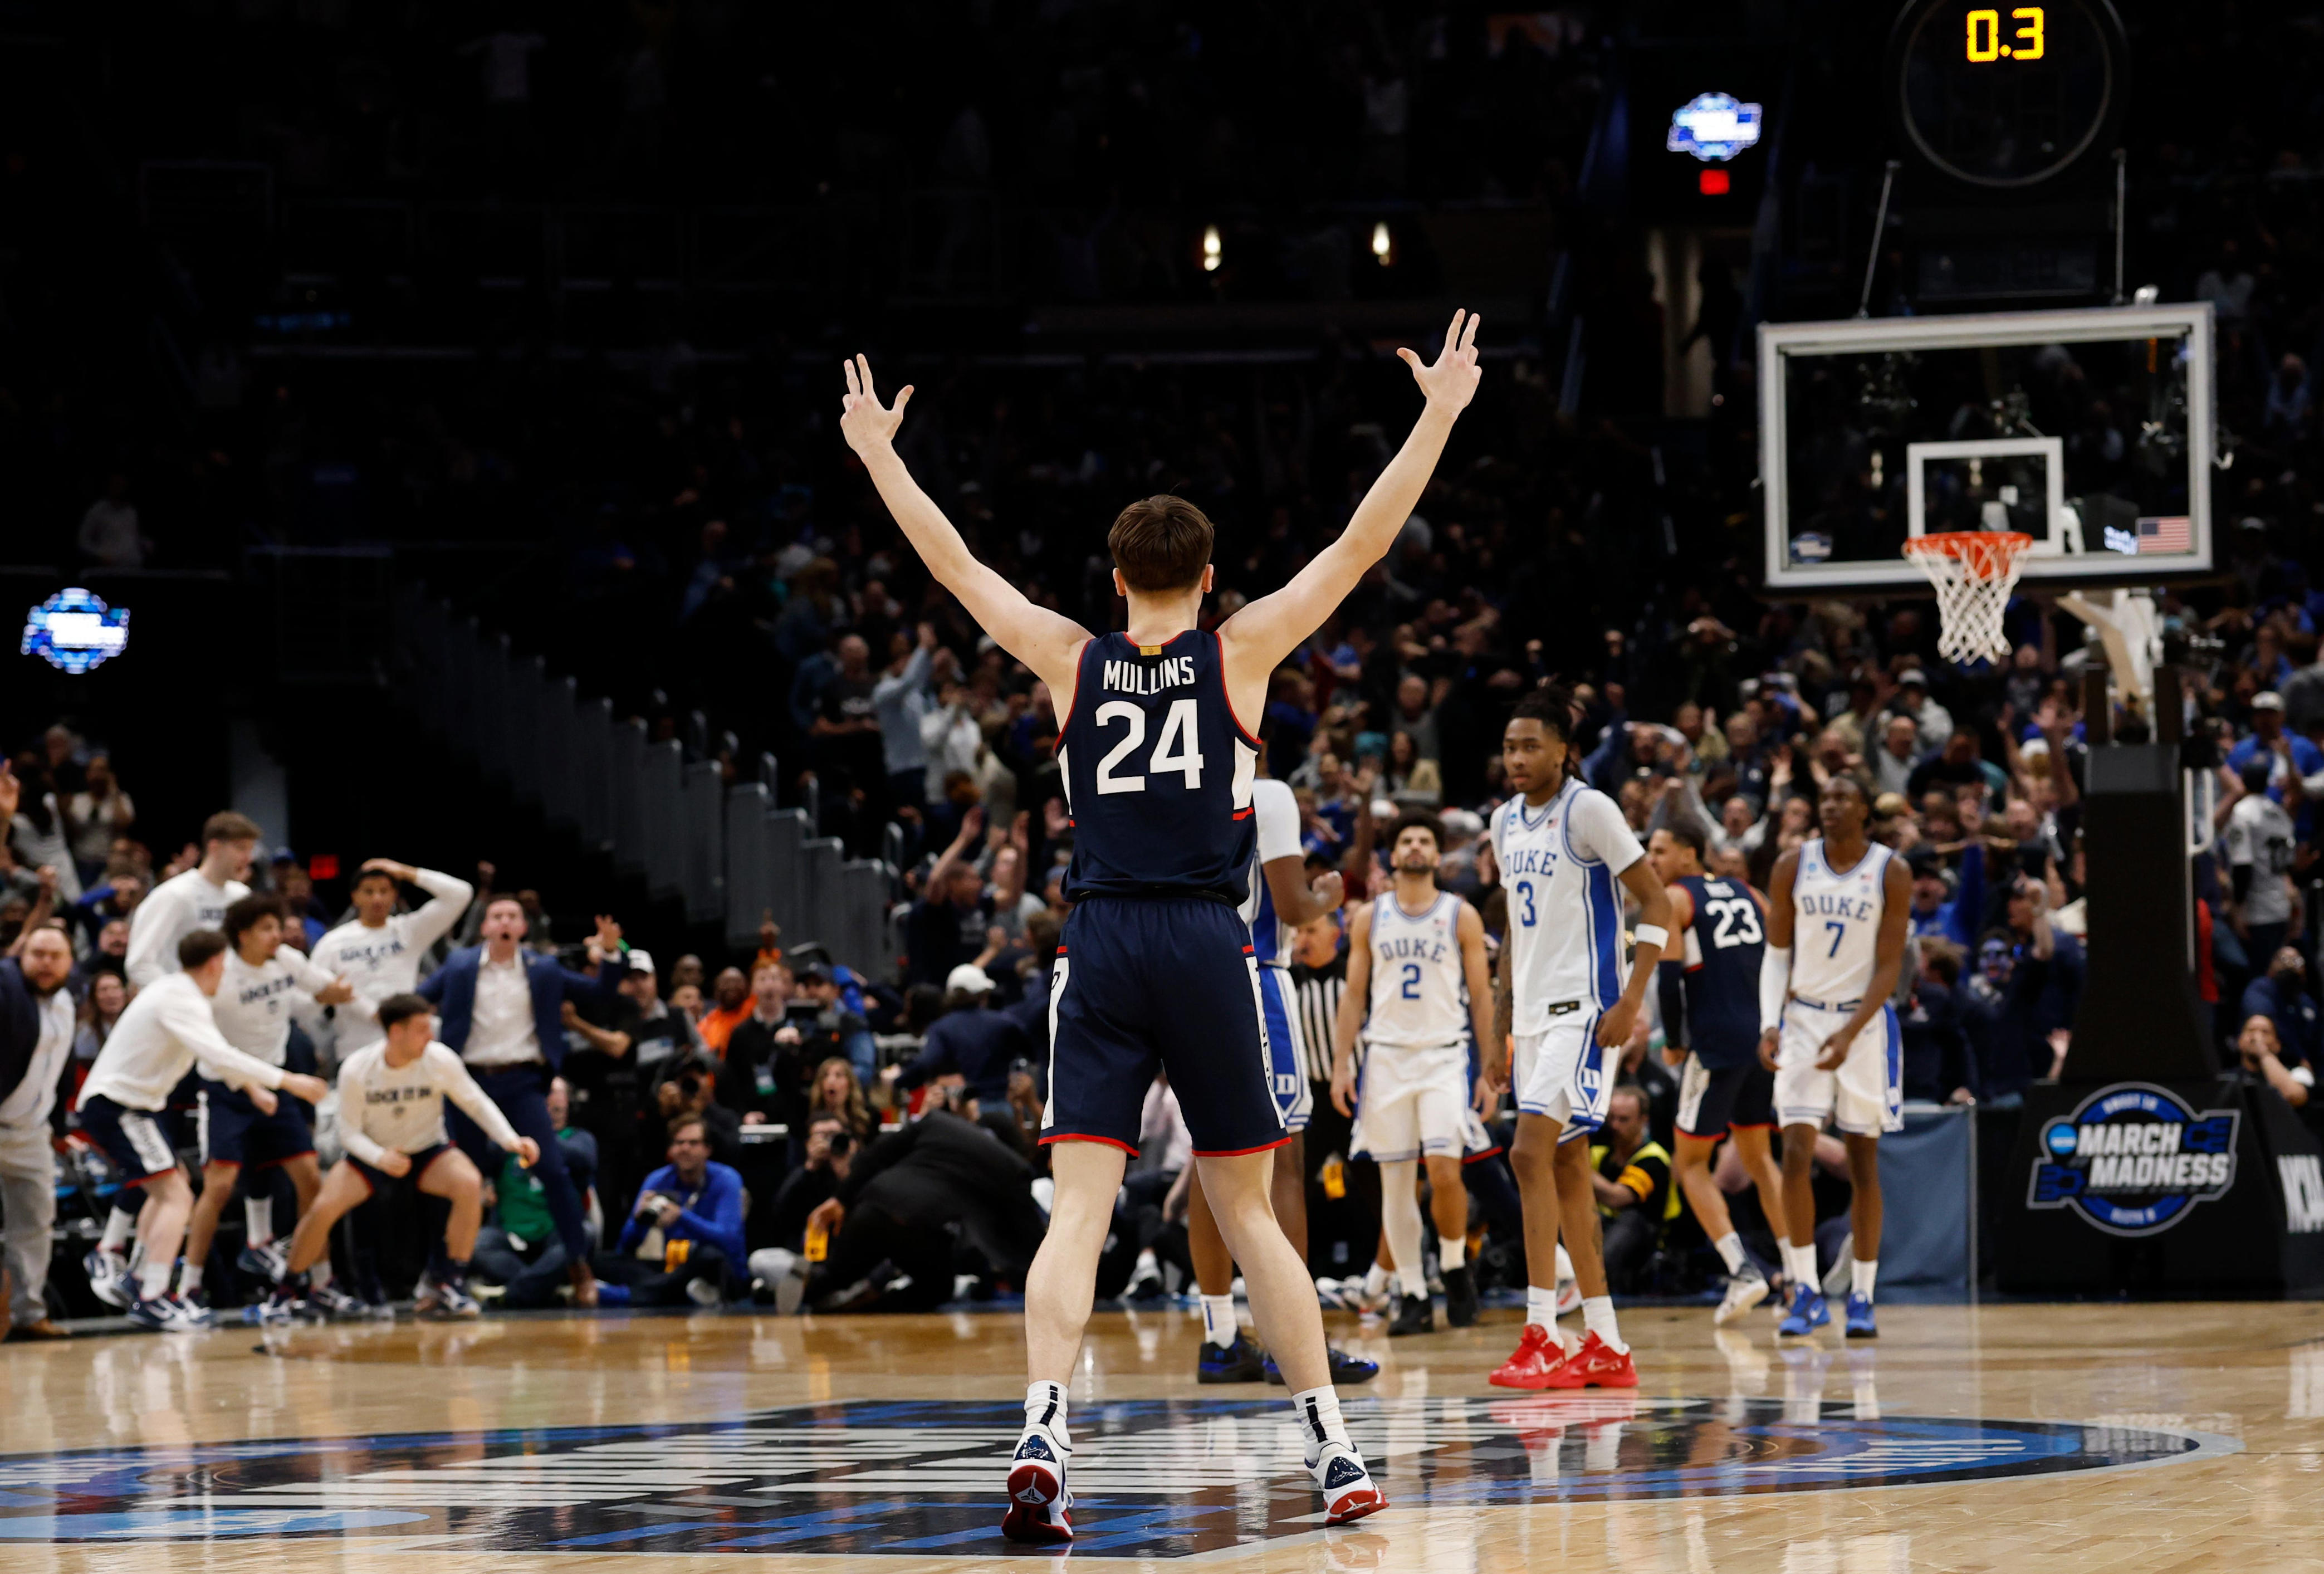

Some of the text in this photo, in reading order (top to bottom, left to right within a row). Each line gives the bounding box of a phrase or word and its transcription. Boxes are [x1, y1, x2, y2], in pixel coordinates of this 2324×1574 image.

[1966, 7, 2044, 62] 0.3
[1103, 656, 1195, 695] MULLINS
[1095, 698, 1204, 795] 24
[1516, 881, 1536, 927] 3
[1801, 894, 1873, 922] DUKE
[1705, 898, 1763, 949] 23
[1824, 921, 1846, 957] 7
[1379, 937, 1448, 963] DUKE
[1402, 963, 1421, 999] 2
[1275, 1073, 1296, 1095] D
[2076, 1122, 2183, 1156] MARCH
[2088, 1152, 2229, 1188] MADNESS
